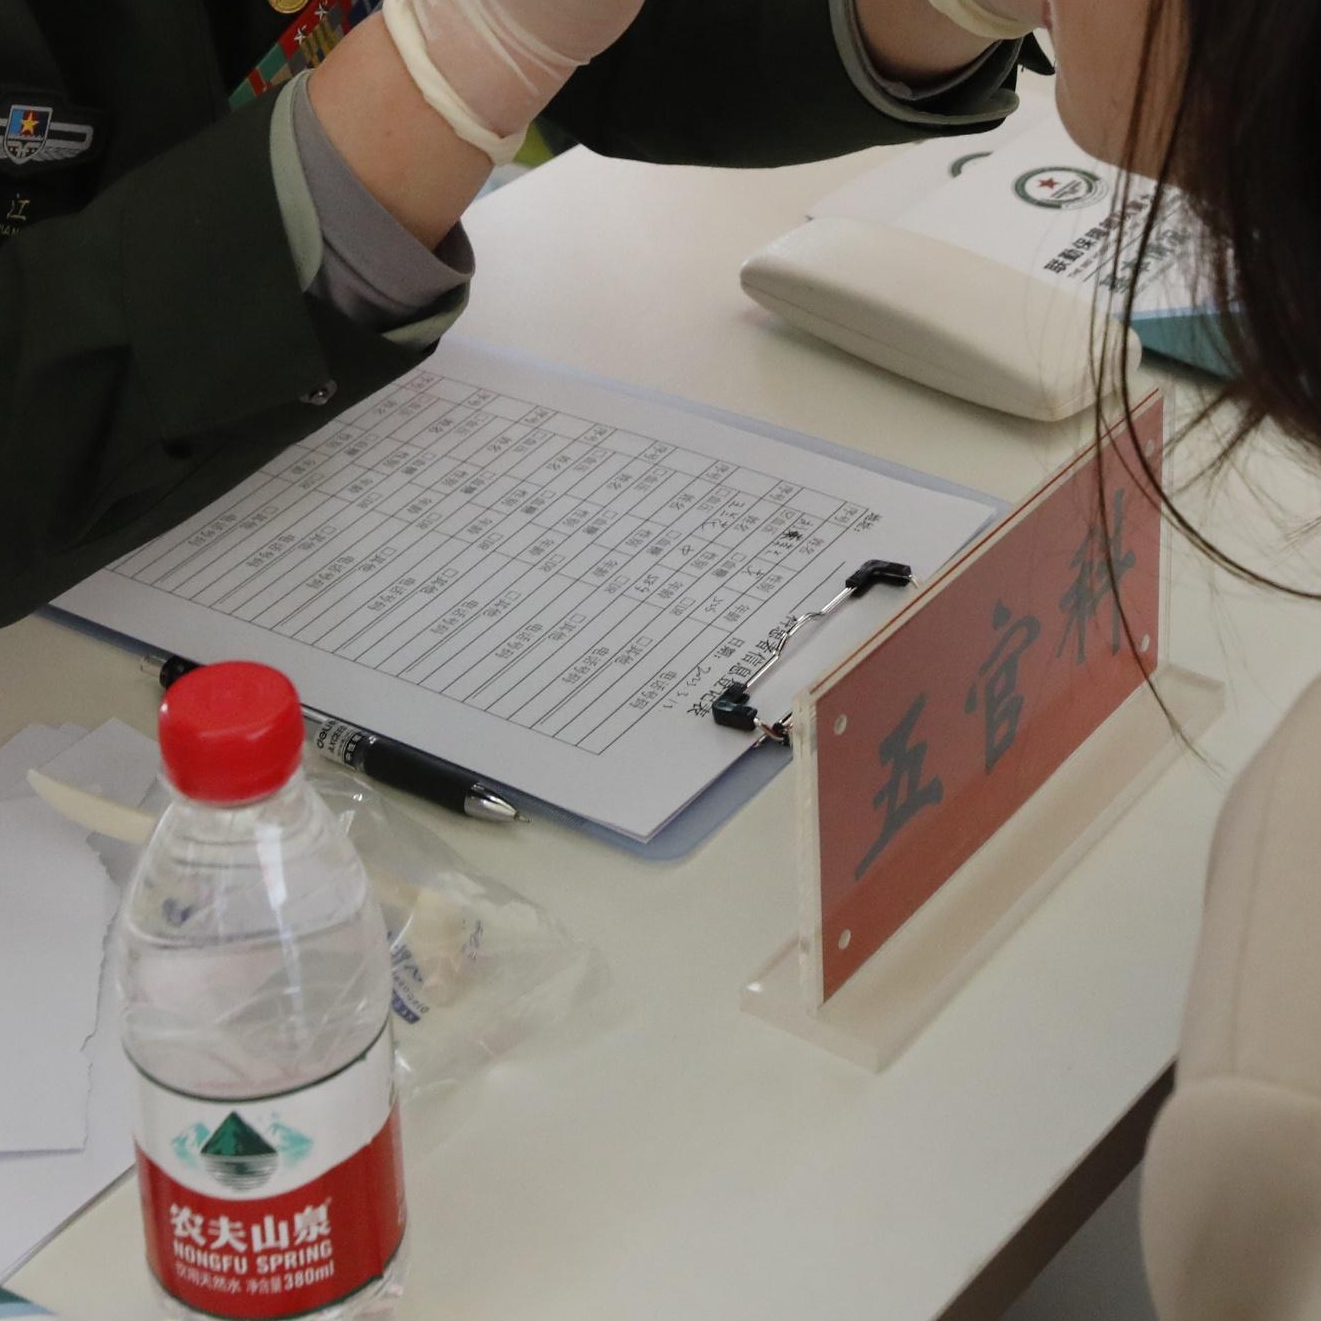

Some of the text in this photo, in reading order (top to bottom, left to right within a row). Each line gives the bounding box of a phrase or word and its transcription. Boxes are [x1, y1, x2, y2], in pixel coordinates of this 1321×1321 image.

[855, 488, 1135, 880] 五官科
[170, 1203, 331, 1252] 农夫山泉
[174, 1239, 333, 1274] NONGFU SPRING
